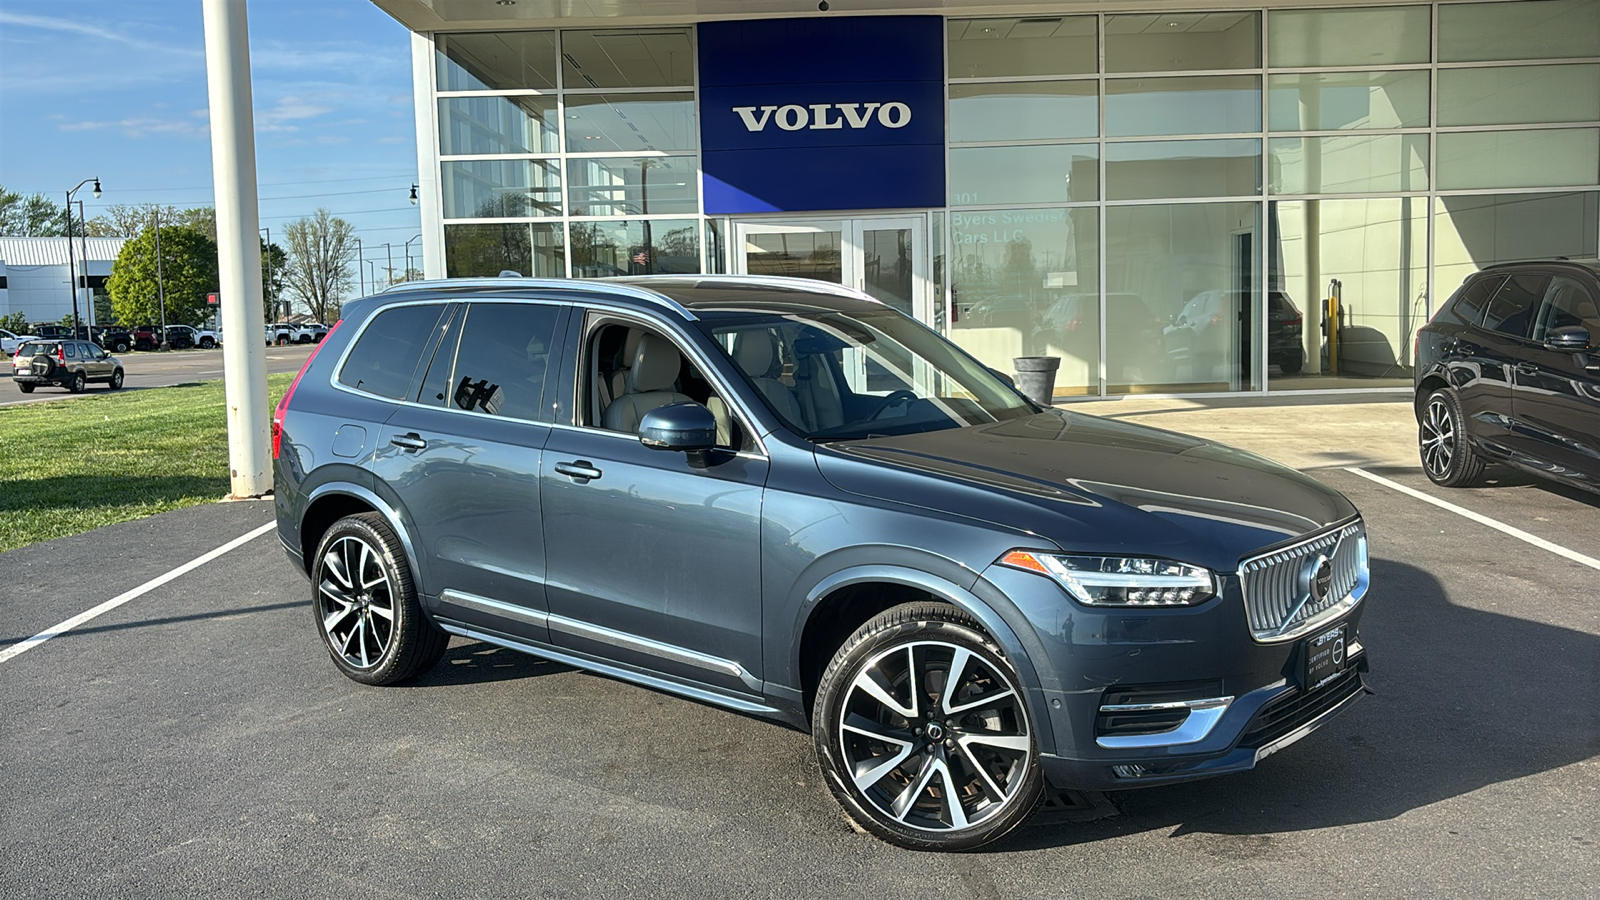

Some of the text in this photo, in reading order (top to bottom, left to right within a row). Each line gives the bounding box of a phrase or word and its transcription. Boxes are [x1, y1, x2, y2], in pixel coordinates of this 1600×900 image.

[732, 101, 912, 132] VOLVO
[952, 213, 996, 229] Byers
[952, 229, 1024, 244] Cars LLC
[1317, 627, 1339, 646] BYERS
